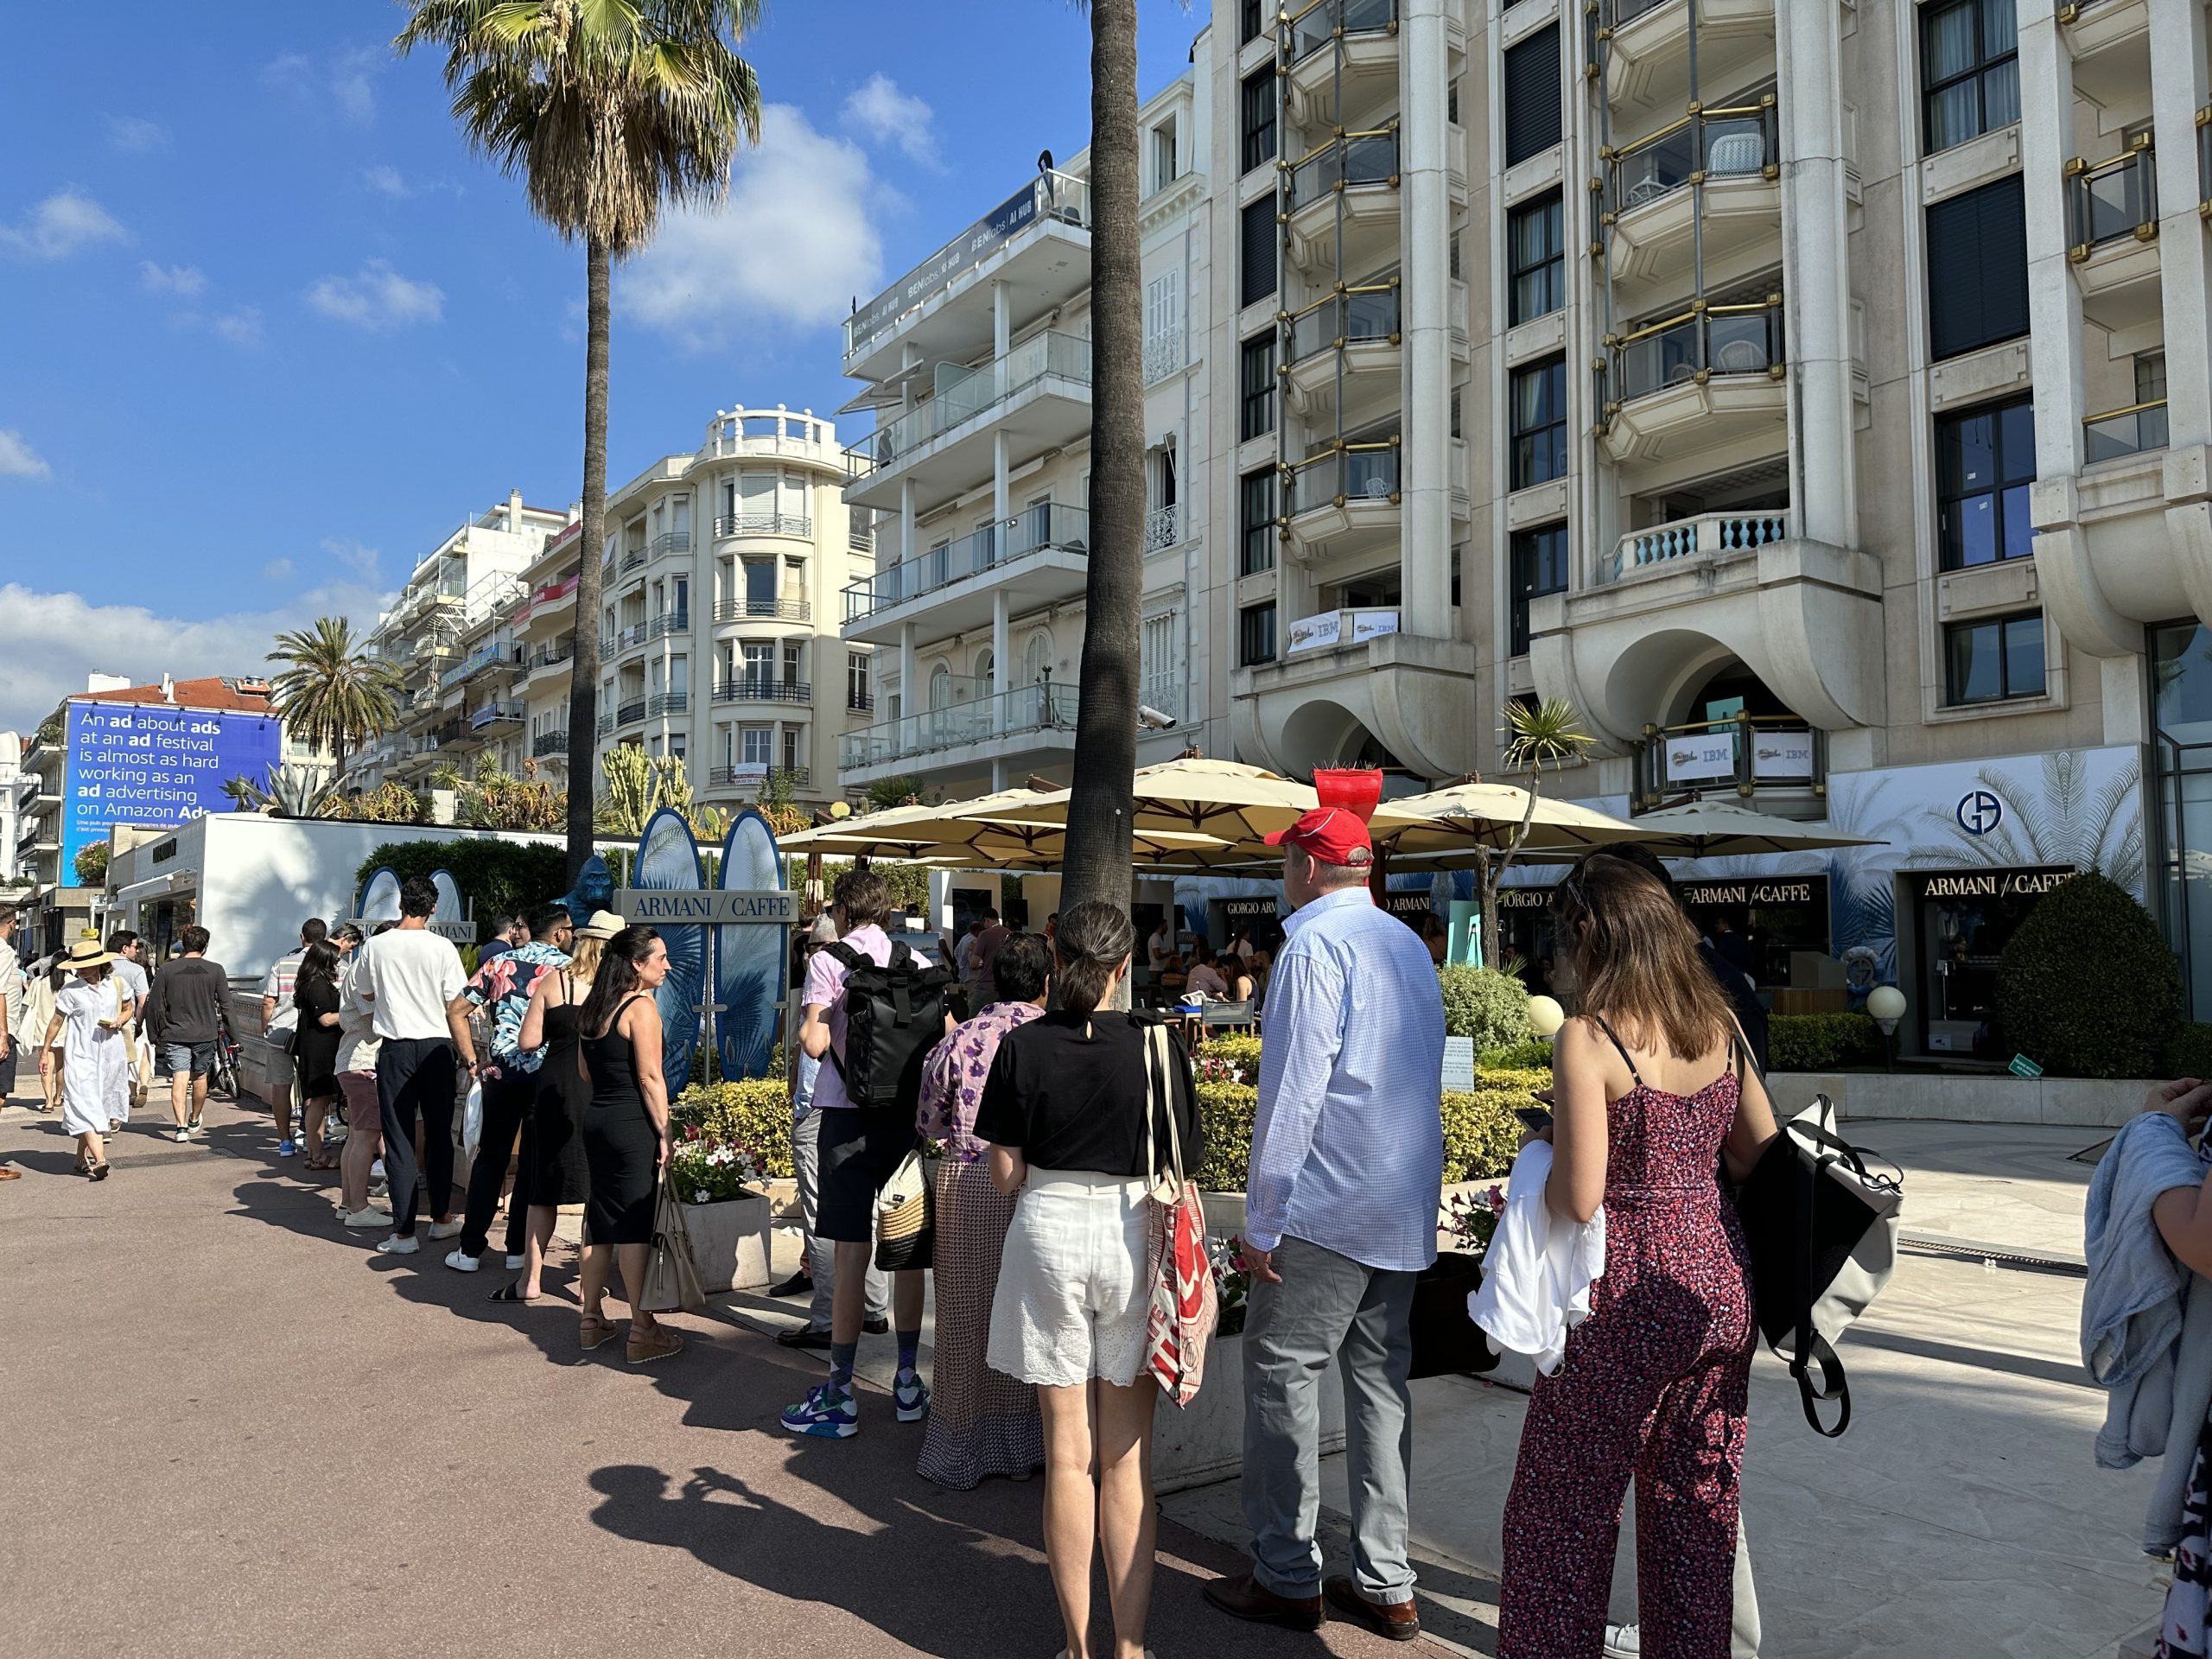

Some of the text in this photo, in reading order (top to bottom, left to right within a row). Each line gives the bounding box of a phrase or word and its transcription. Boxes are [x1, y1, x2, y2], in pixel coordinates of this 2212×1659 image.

[971, 200, 1032, 252] BENlabs AI HUB
[1317, 621, 1338, 638] IBM
[80, 713, 220, 734] An ad about ads
[80, 732, 213, 752] at an ad festival
[79, 748, 219, 769] is almost as hard
[1703, 748, 1728, 762] IBM
[1785, 749, 1809, 760] IBM
[79, 766, 194, 785] working as an
[77, 784, 197, 805] ad advertising
[77, 804, 99, 816] on
[104, 803, 174, 818] Amazon
[1925, 876, 1997, 896] ARMANI
[2014, 872, 2075, 894] CAFF
[1503, 893, 1542, 907] IORGIO
[1691, 887, 1746, 904] ARMANI
[633, 896, 712, 917] ARMANI
[1227, 901, 1277, 914] GIORGIO ARM
[1393, 897, 1430, 912] ARMANI
[429, 925, 473, 939] RMANI
